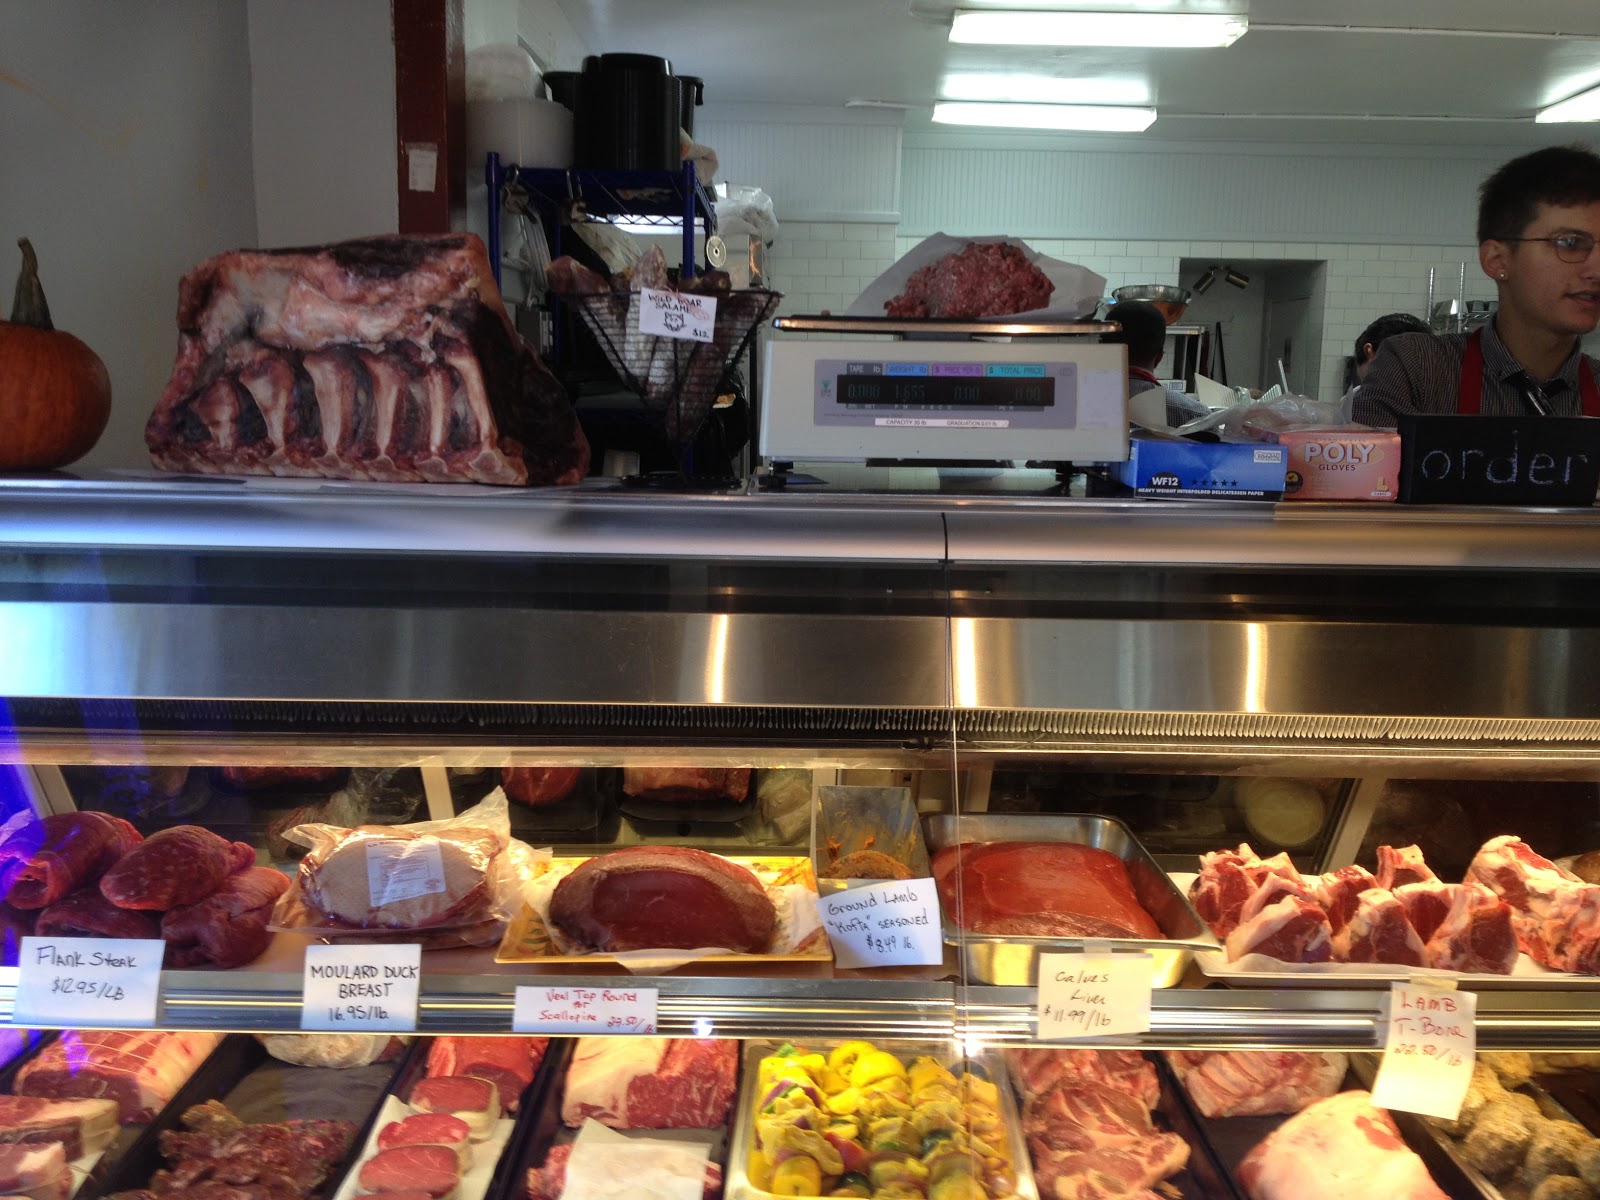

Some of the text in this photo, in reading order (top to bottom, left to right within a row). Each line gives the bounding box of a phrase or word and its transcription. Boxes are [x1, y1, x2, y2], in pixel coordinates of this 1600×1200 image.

[655, 302, 689, 313] SALAMI
[692, 328, 709, 338] $12
[849, 365, 881, 373] TARE lb
[889, 366, 914, 374] WEIGHT
[1000, 366, 1020, 374] TOTAL
[1023, 367, 1043, 375] PRICE
[1304, 442, 1376, 463] POLY
[1421, 429, 1588, 485] order
[1152, 477, 1179, 486] WF12
[1376, 476, 1389, 491] L
[310, 965, 419, 980] MOULARD DUCK
[1055, 970, 1110, 984] Calves
[338, 982, 393, 999] BREAST
[547, 989, 637, 1002] Veal Top Round
[1070, 989, 1106, 1005] Liver
